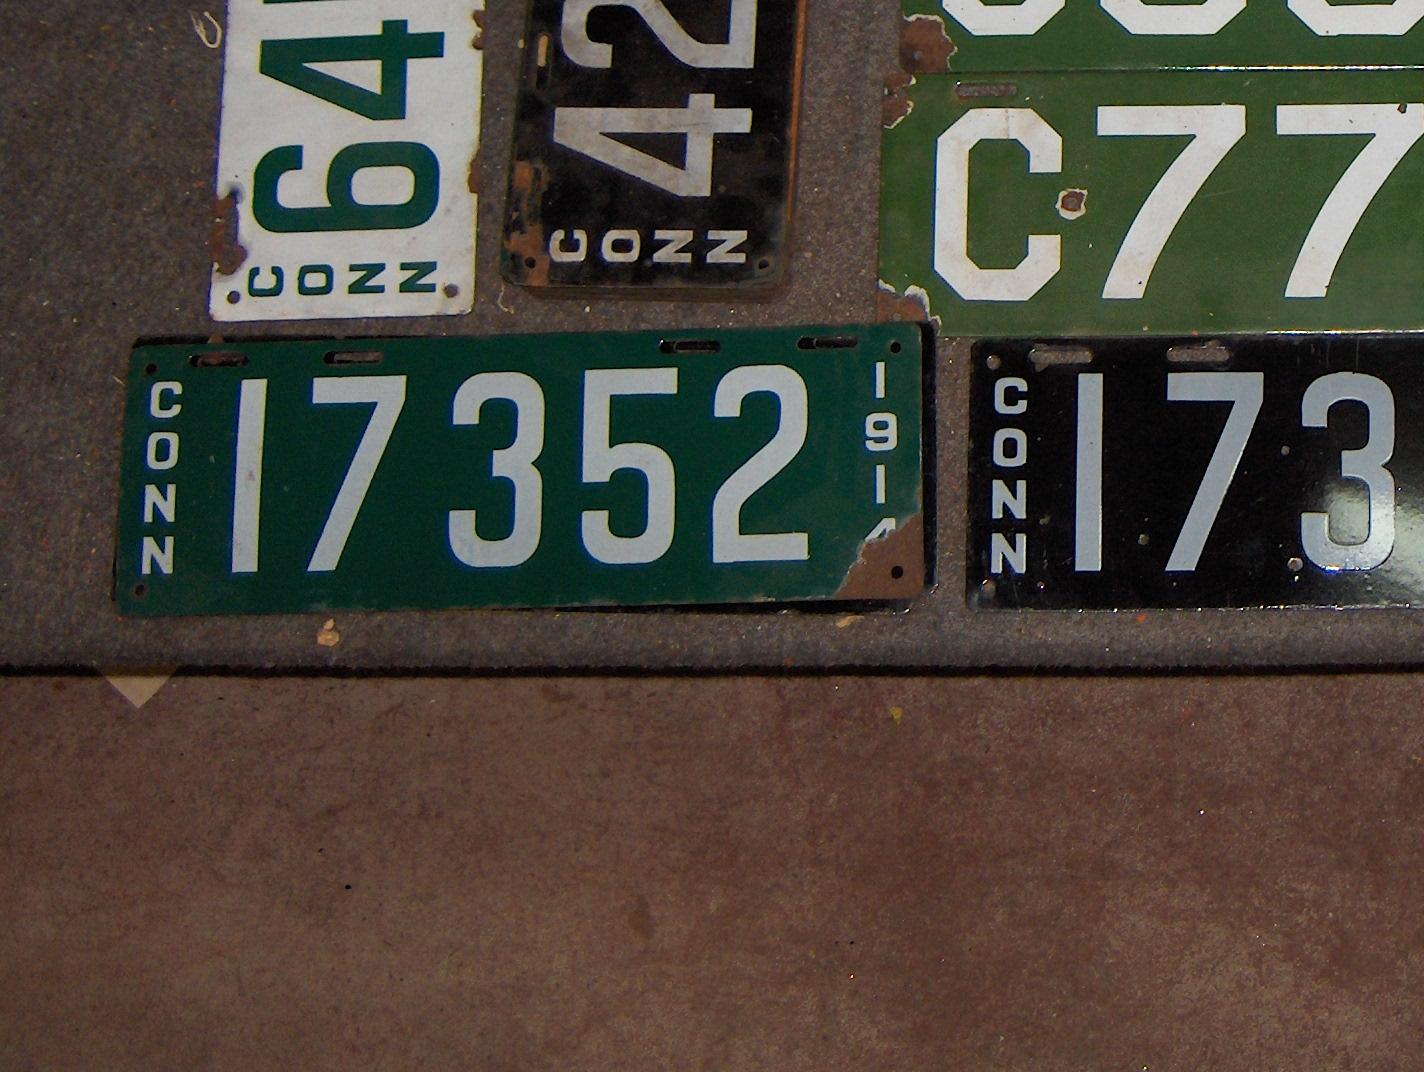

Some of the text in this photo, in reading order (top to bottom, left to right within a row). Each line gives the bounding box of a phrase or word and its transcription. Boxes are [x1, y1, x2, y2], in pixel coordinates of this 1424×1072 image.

[247, 259, 440, 297] CONN
[549, 227, 748, 264] CONN
[141, 381, 183, 575] CONN
[231, 365, 809, 573] 17352
[992, 377, 1028, 575] CONN
